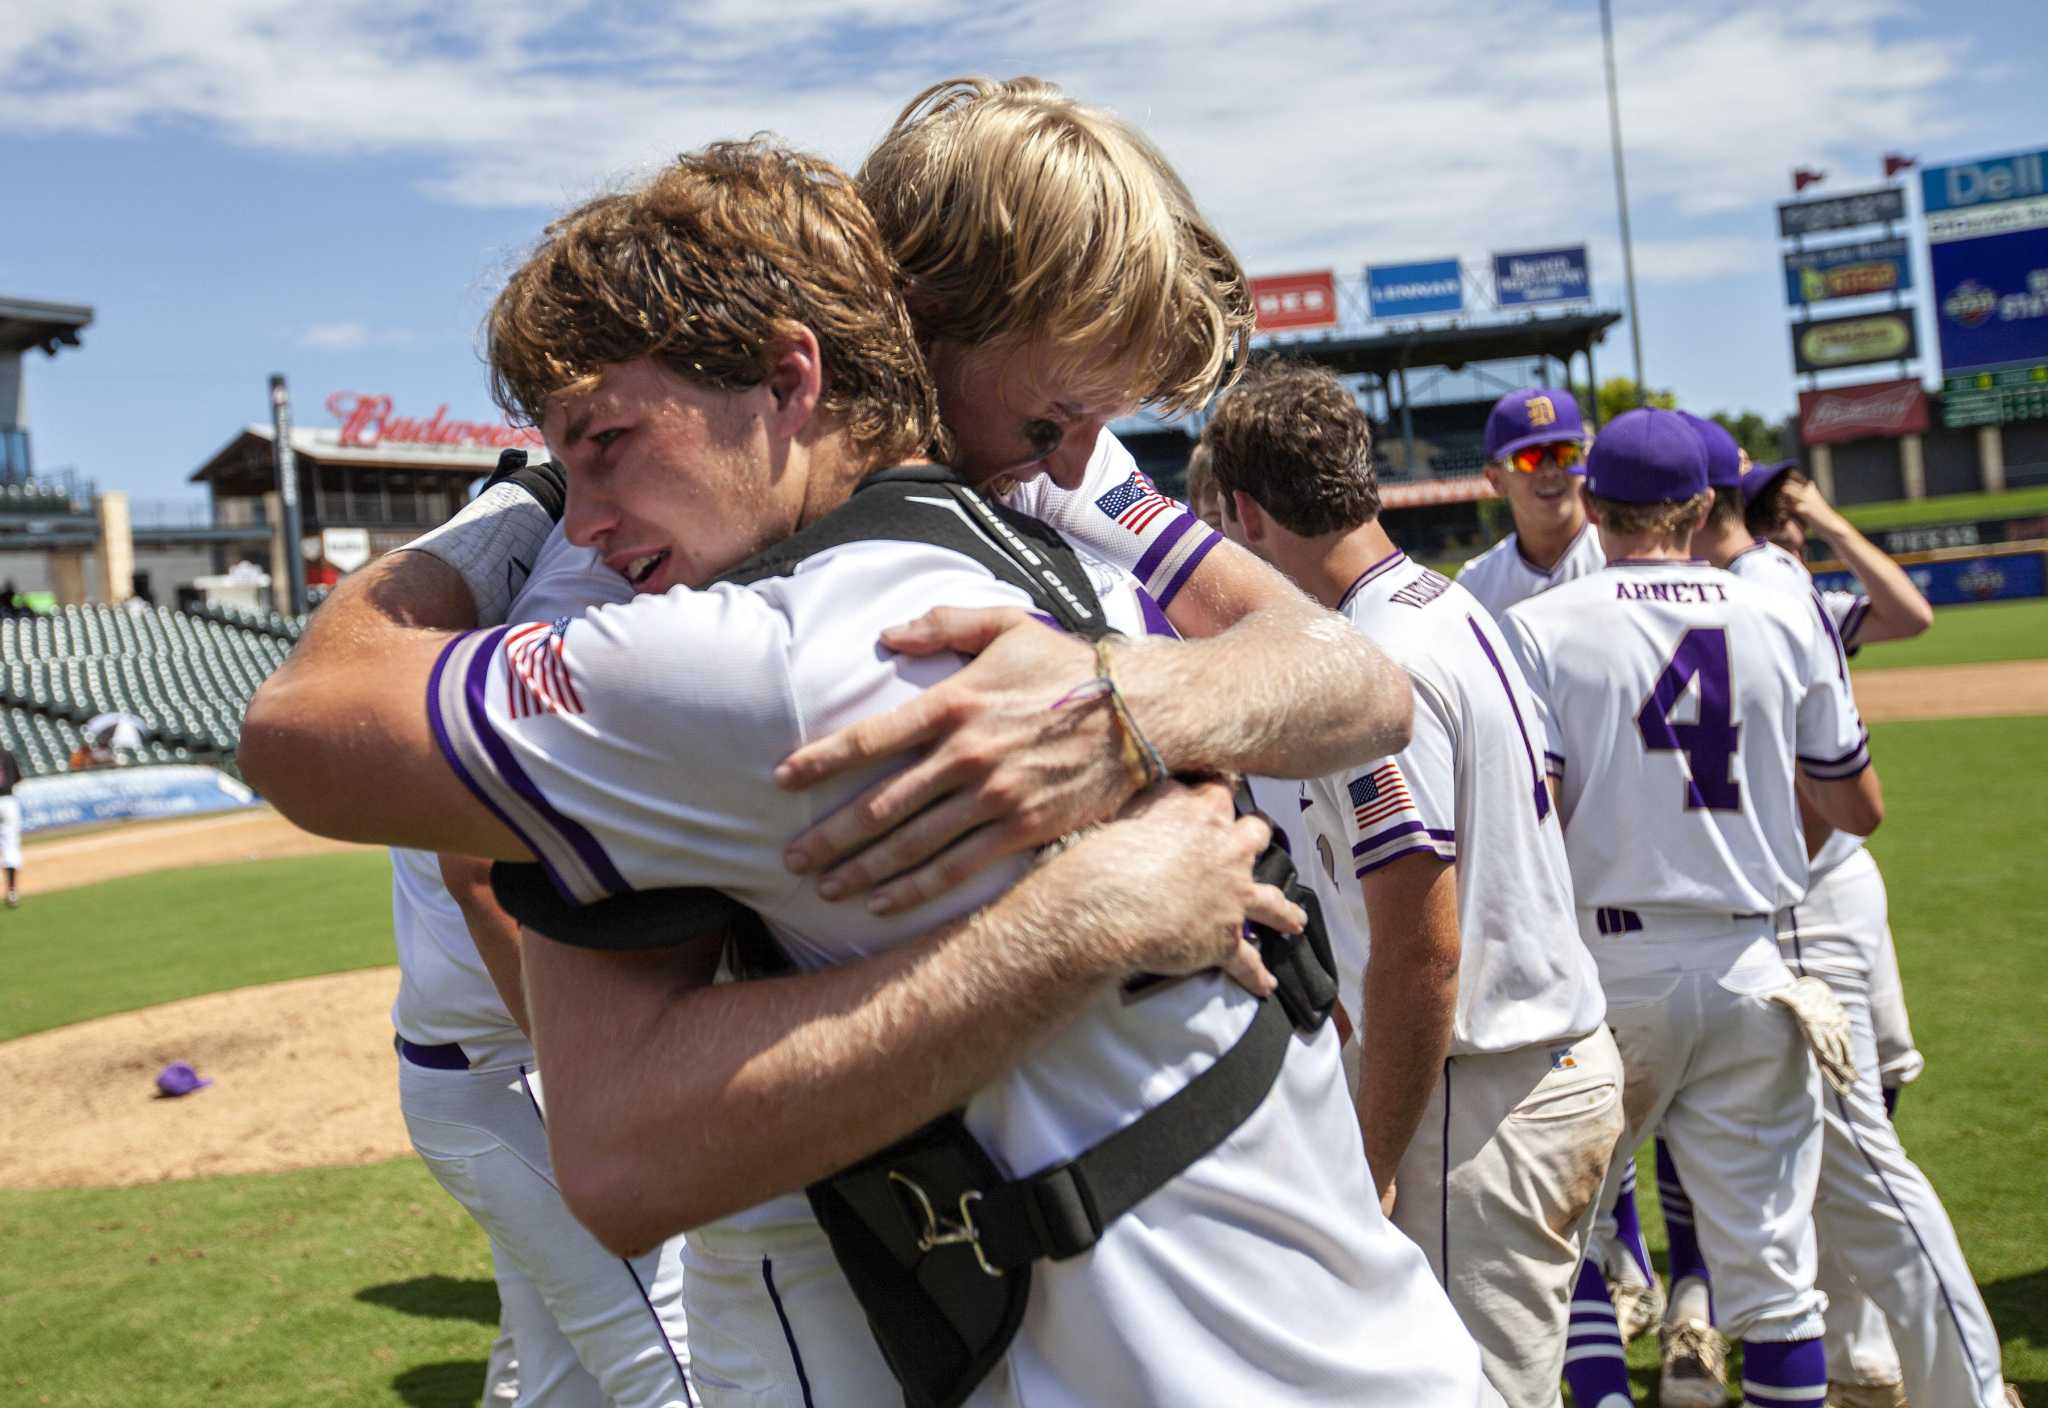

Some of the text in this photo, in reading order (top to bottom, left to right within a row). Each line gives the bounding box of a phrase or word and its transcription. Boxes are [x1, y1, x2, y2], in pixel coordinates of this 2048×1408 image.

[1945, 153, 2043, 206] Dell
[1373, 279, 1458, 302] LENNAR
[1042, 570, 1093, 619] PRO
[1616, 582, 1728, 602] ARNETT
[1633, 624, 1743, 812] 4
